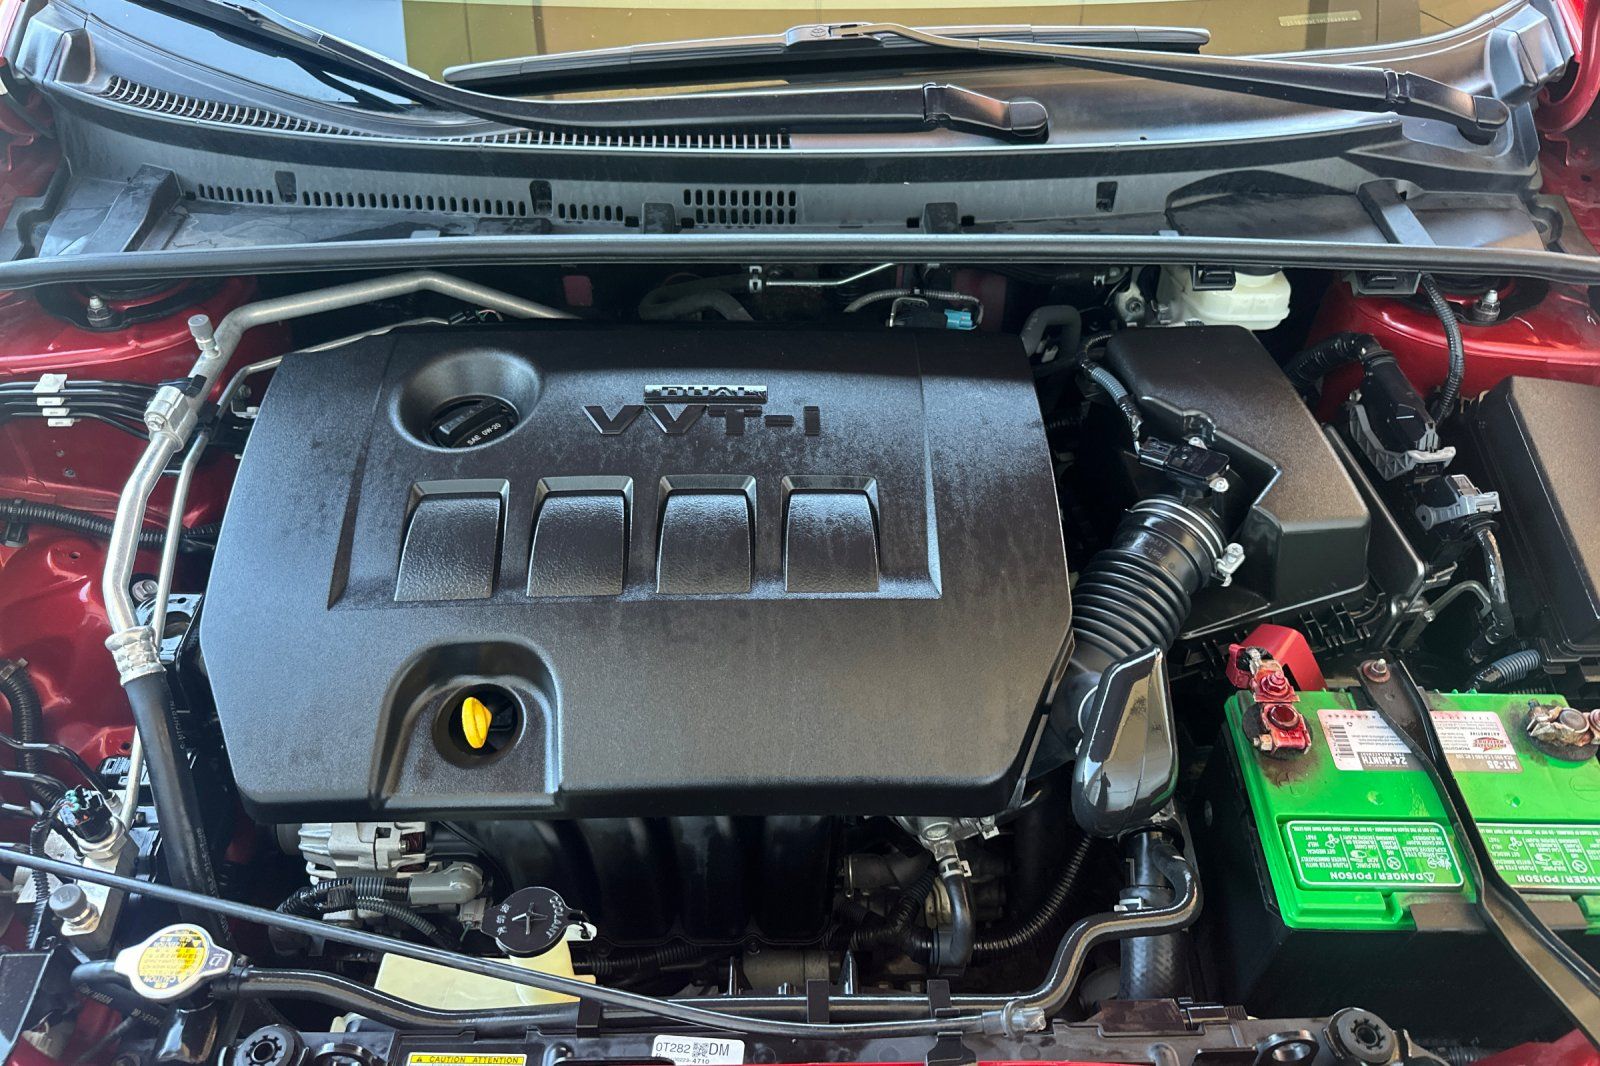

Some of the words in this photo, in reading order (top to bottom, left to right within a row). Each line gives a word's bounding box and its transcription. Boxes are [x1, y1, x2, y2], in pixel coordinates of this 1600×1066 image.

[467, 434, 482, 446] SAE
[482, 422, 502, 436] 0W-20
[1362, 756, 1408, 765] 24-MONTH
[546, 895, 564, 940] COOLANT
[708, 1042, 730, 1056] DM
